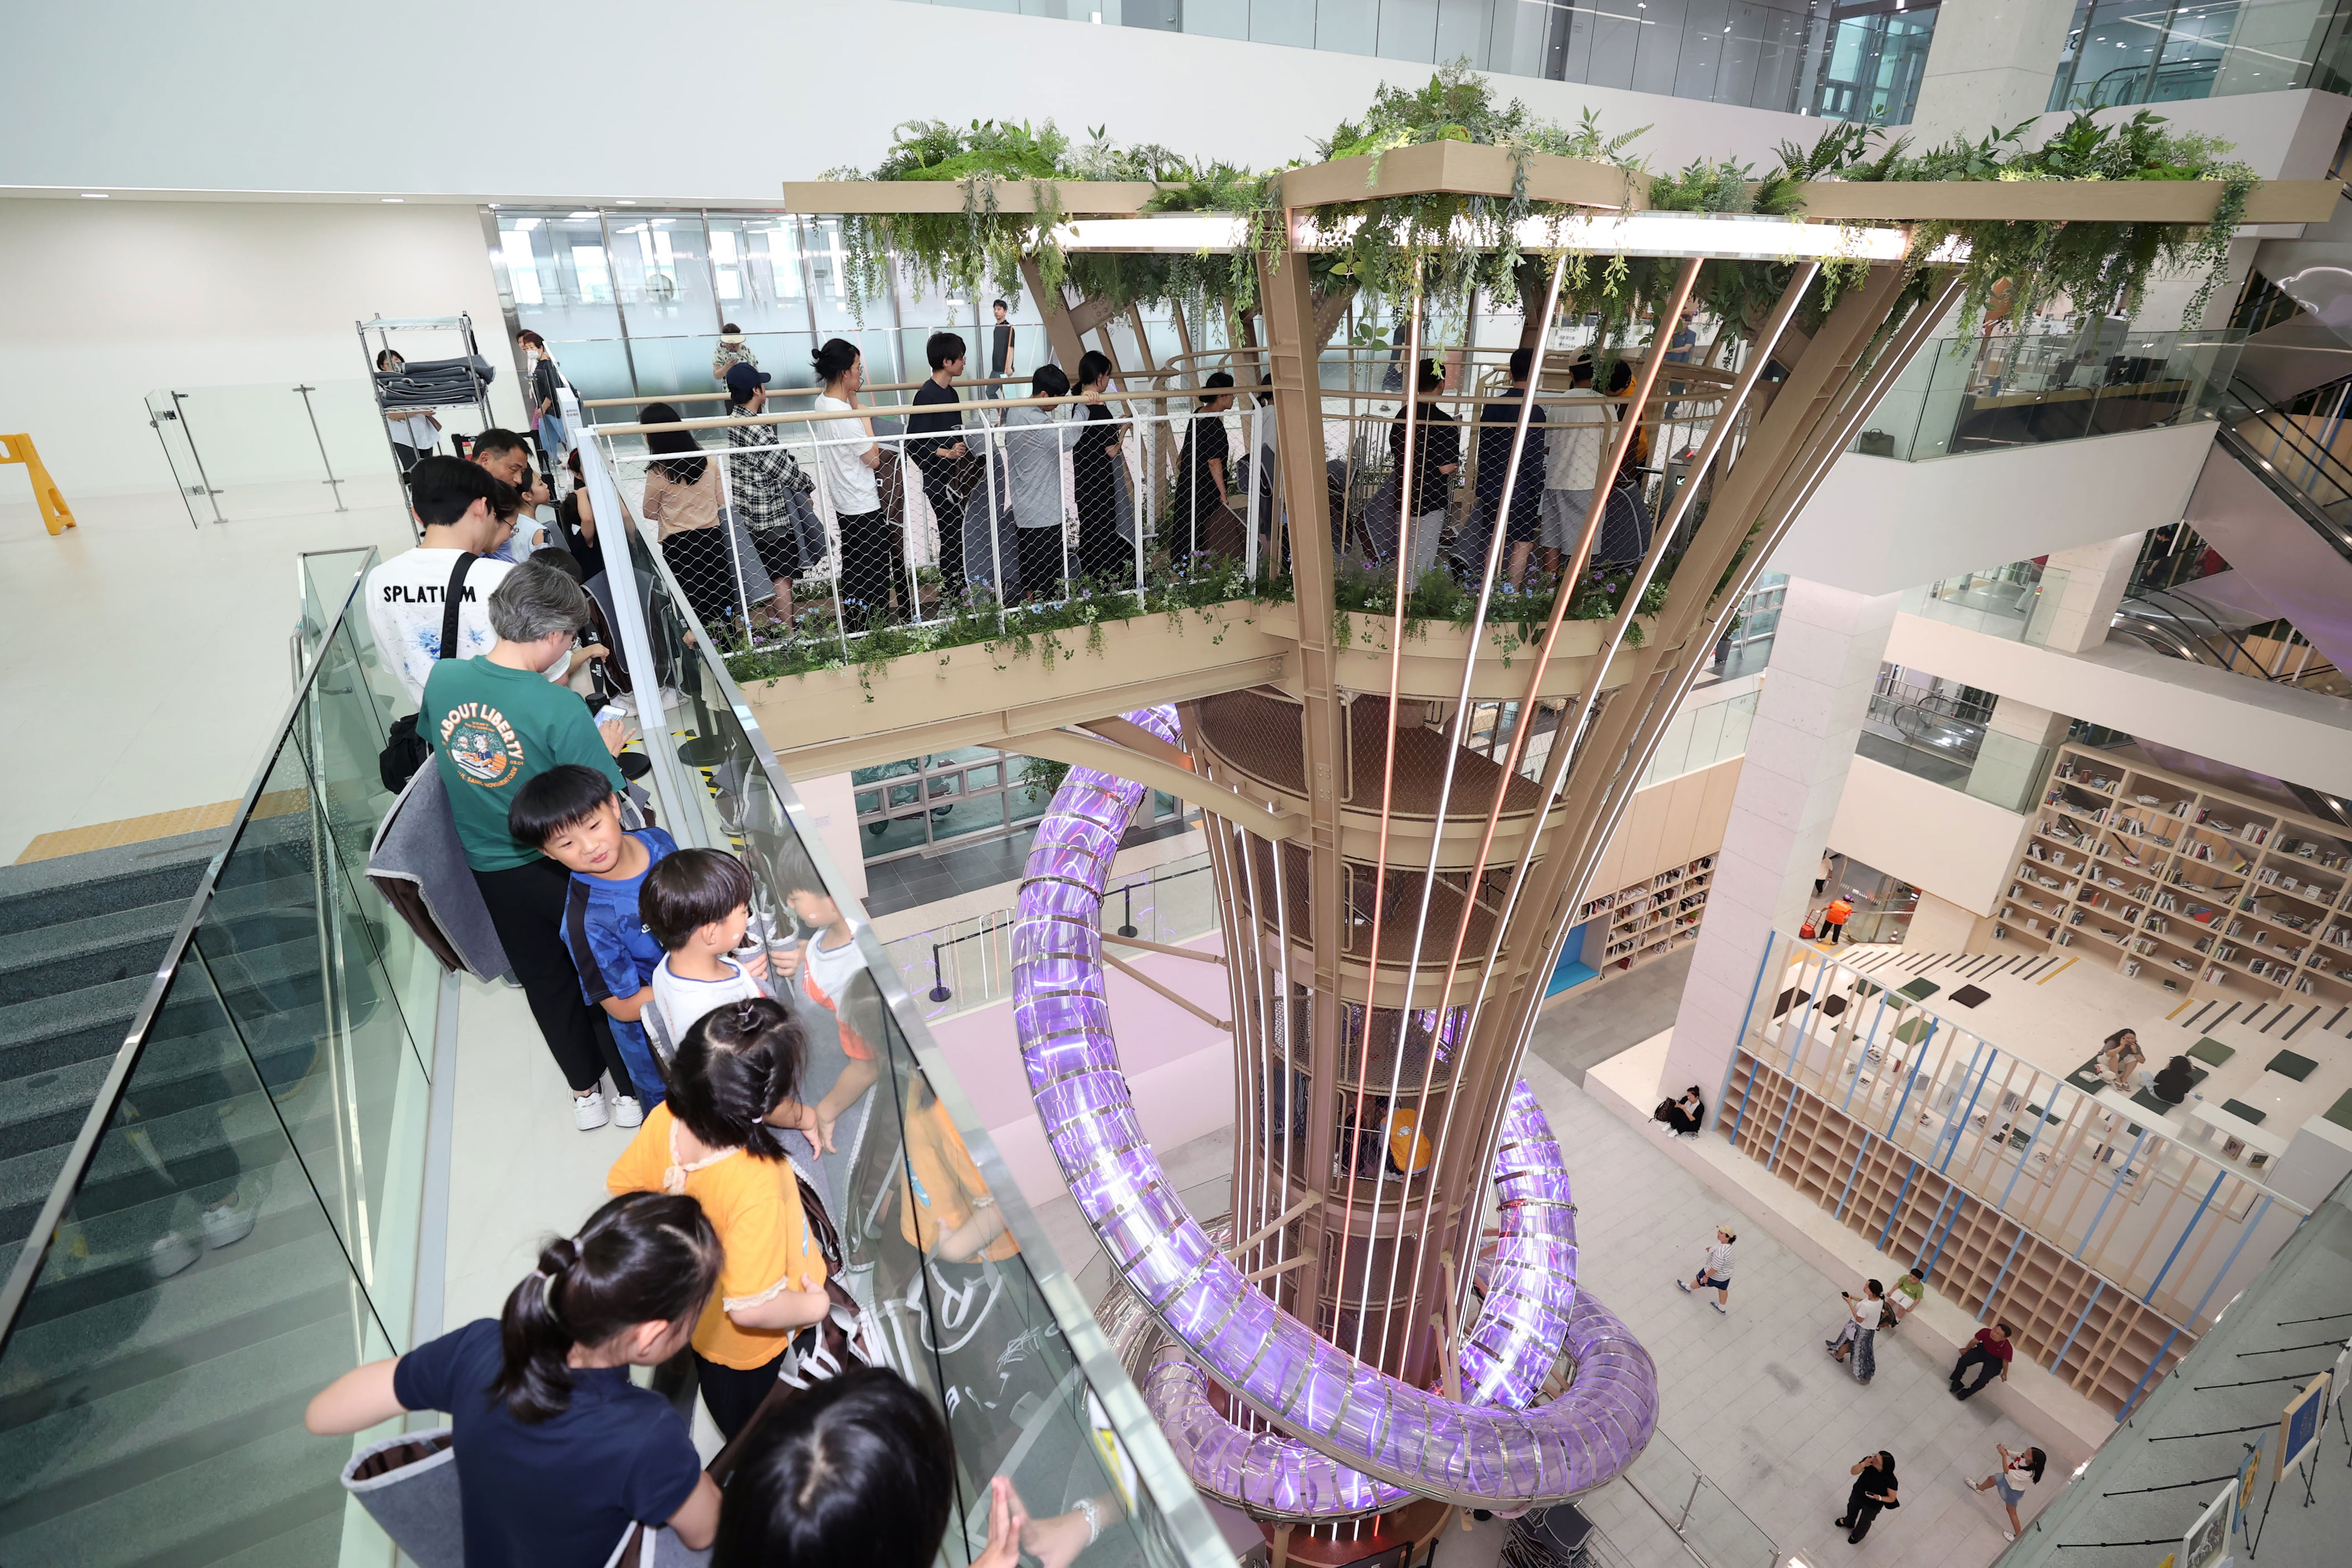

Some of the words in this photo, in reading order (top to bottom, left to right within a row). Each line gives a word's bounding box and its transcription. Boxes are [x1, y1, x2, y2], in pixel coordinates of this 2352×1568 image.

[384, 585, 476, 603] SPLATIM
[440, 702, 479, 742] ABOUT
[480, 703, 525, 761] LIBERTY
